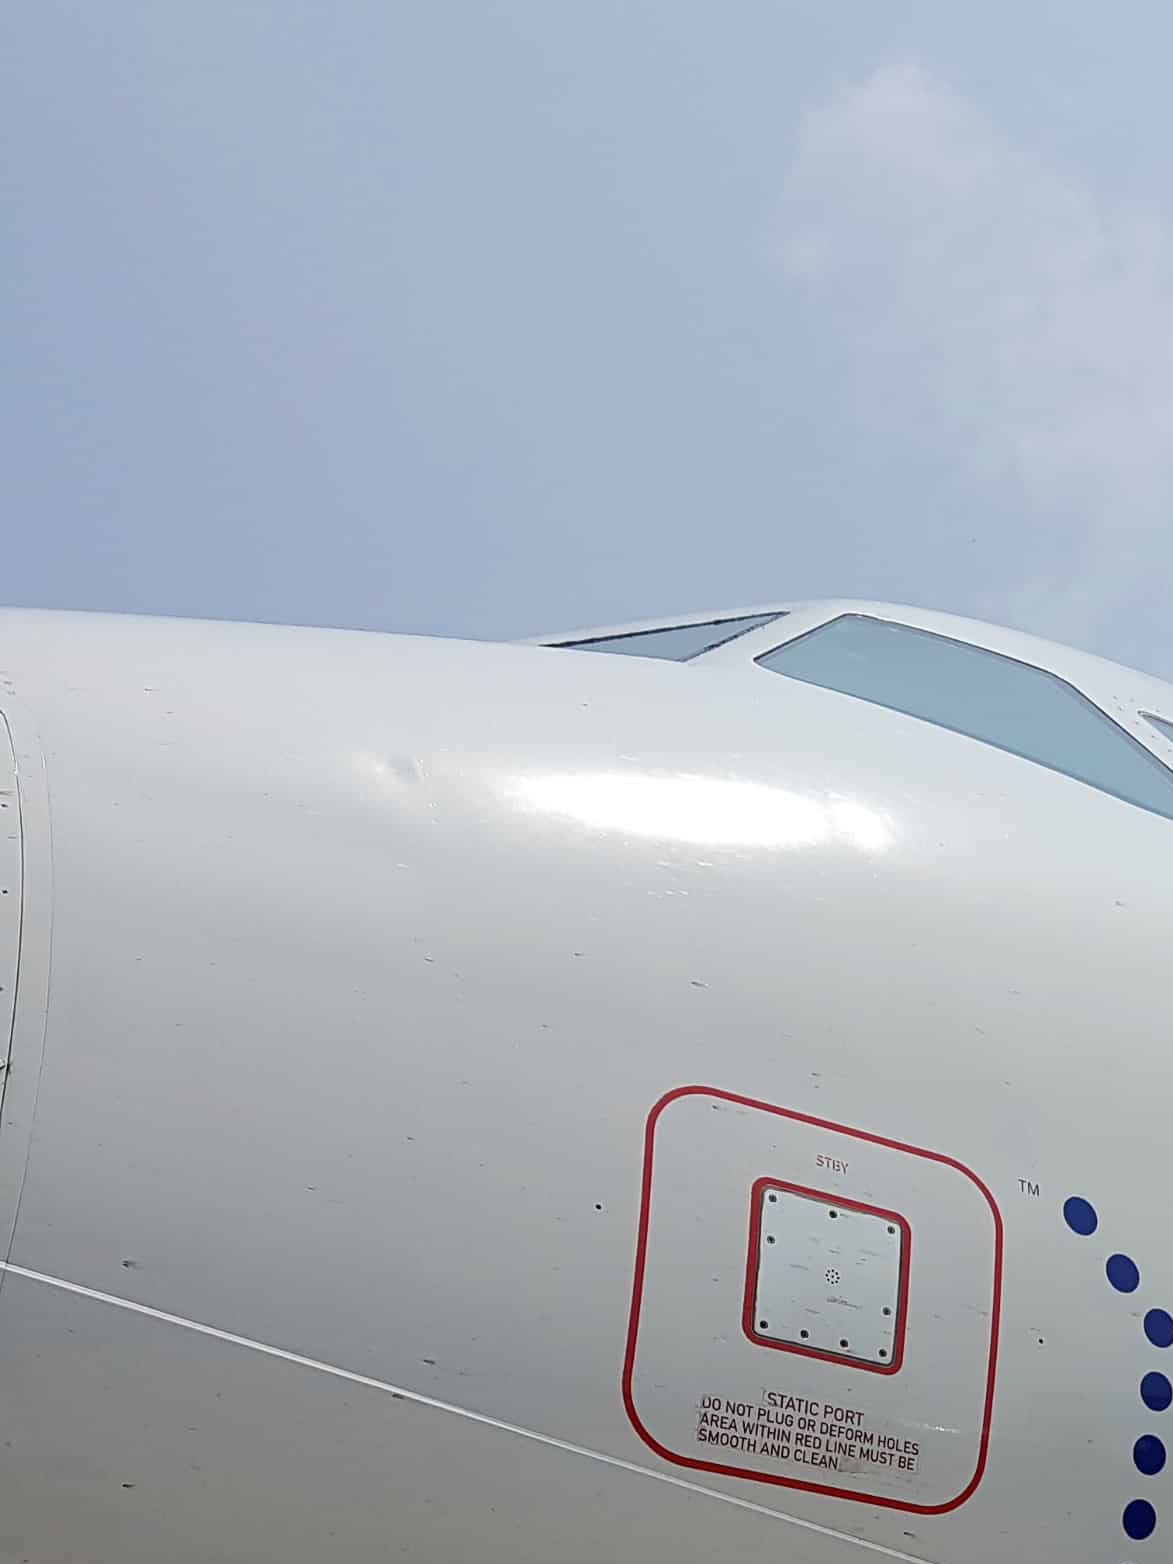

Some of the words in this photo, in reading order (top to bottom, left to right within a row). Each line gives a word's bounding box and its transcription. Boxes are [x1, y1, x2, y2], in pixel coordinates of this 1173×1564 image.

[815, 1154, 849, 1174] STBY
[1018, 1179, 1040, 1197] TM
[702, 1397, 721, 1411] DO
[725, 1400, 754, 1418] NOT
[757, 1407, 794, 1427] PLUG
[797, 1417, 816, 1432] OR
[820, 1421, 874, 1446] DEFORM
[877, 1434, 919, 1455] HOLES
[767, 1392, 820, 1416] STATIC
[823, 1404, 865, 1426] PORT
[698, 1428, 757, 1453] SMOOTH
[760, 1441, 790, 1459] AND
[794, 1449, 839, 1470] CLEAN
[700, 1412, 737, 1432] AREA
[742, 1420, 791, 1443] WITHIN
[795, 1432, 821, 1450] RED
[825, 1439, 857, 1458] LINE
[859, 1446, 894, 1466] MUST
[898, 1455, 915, 1471] BE
